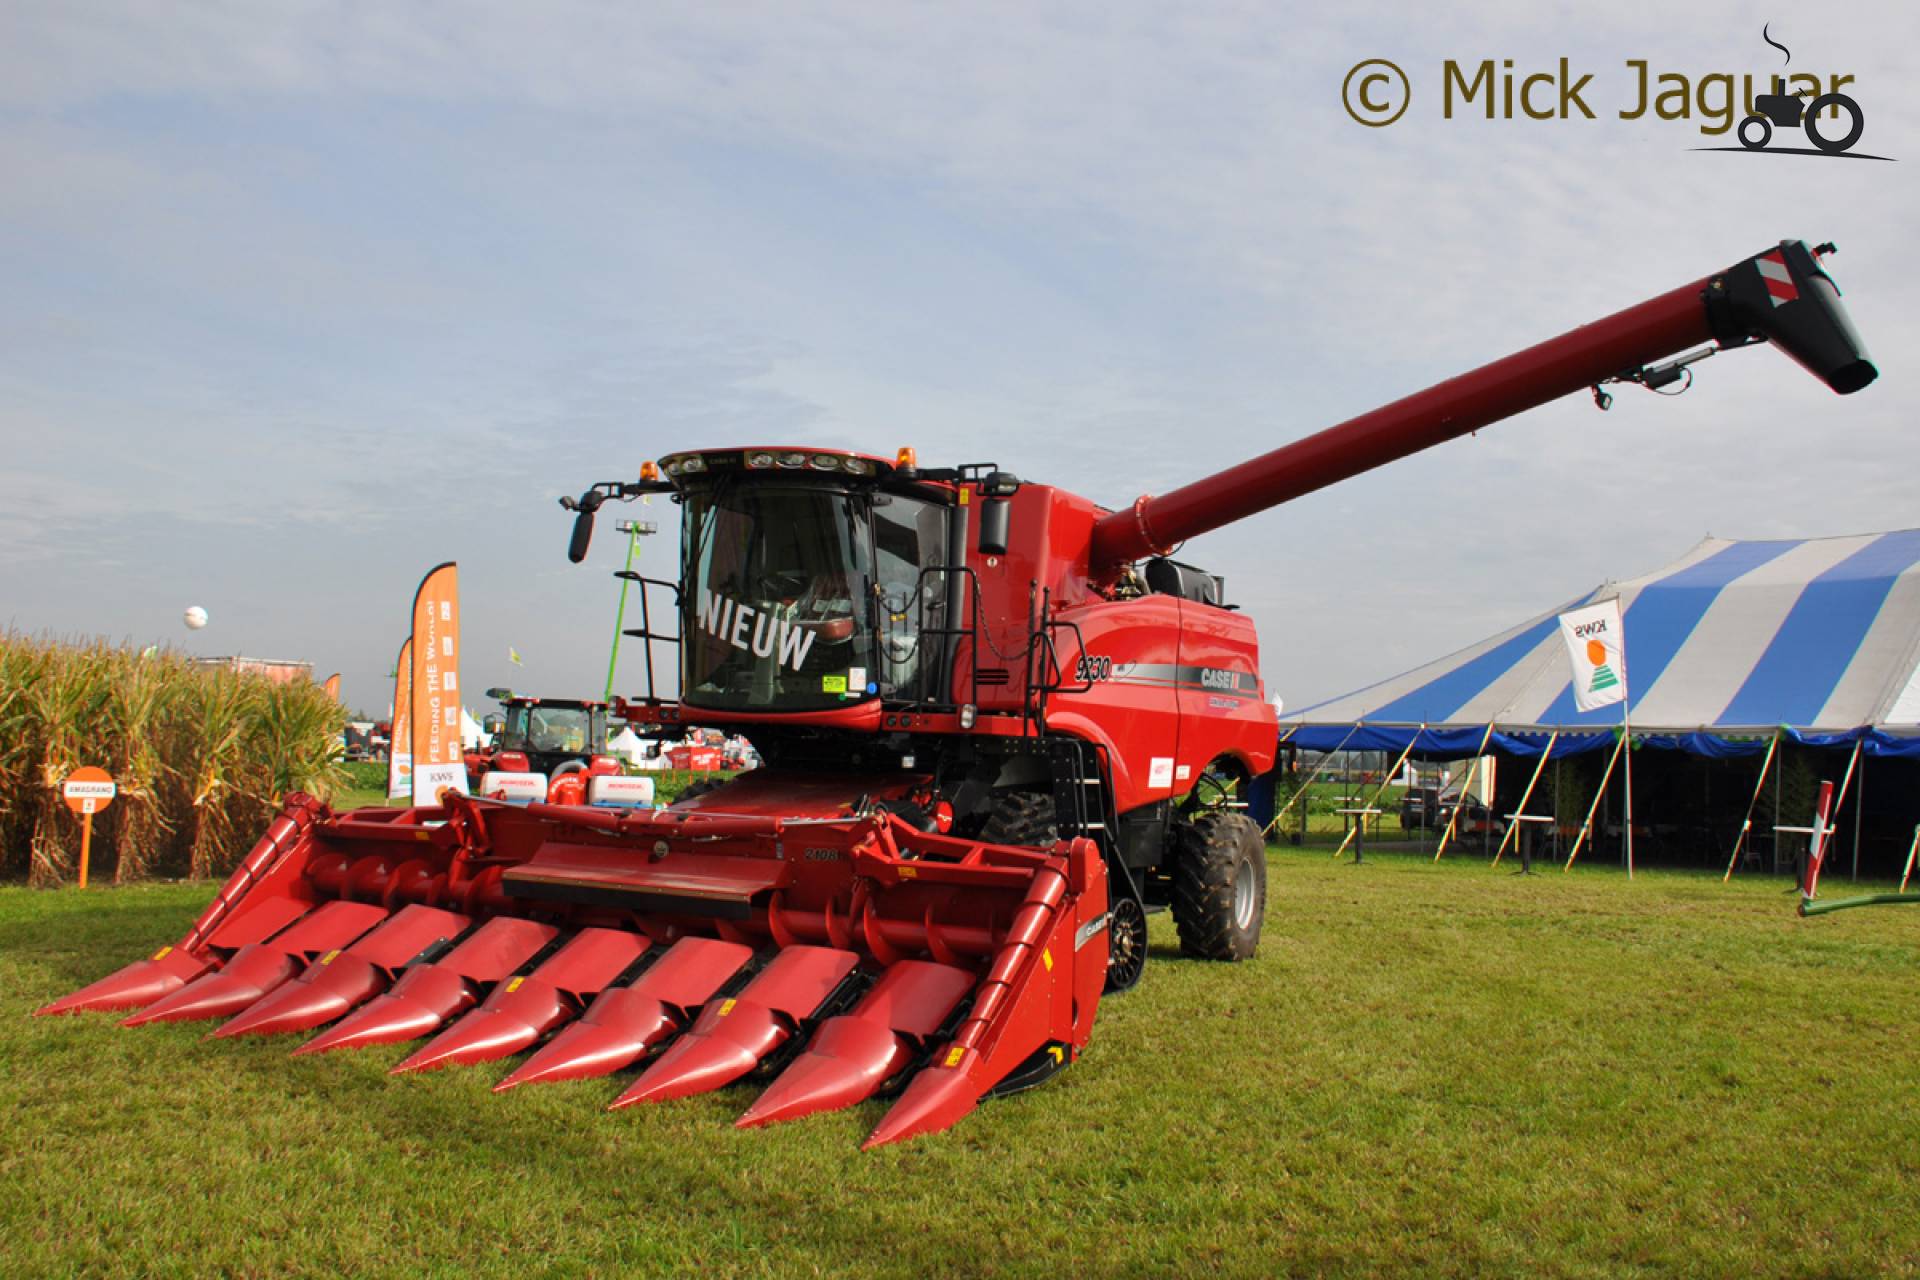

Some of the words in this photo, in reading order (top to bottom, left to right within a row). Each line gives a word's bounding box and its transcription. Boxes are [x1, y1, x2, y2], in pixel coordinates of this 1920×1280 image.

[699, 589, 817, 671] NIEUW
[426, 663, 441, 694] THE
[1075, 656, 1111, 681] 9230
[430, 772, 453, 782] KWS
